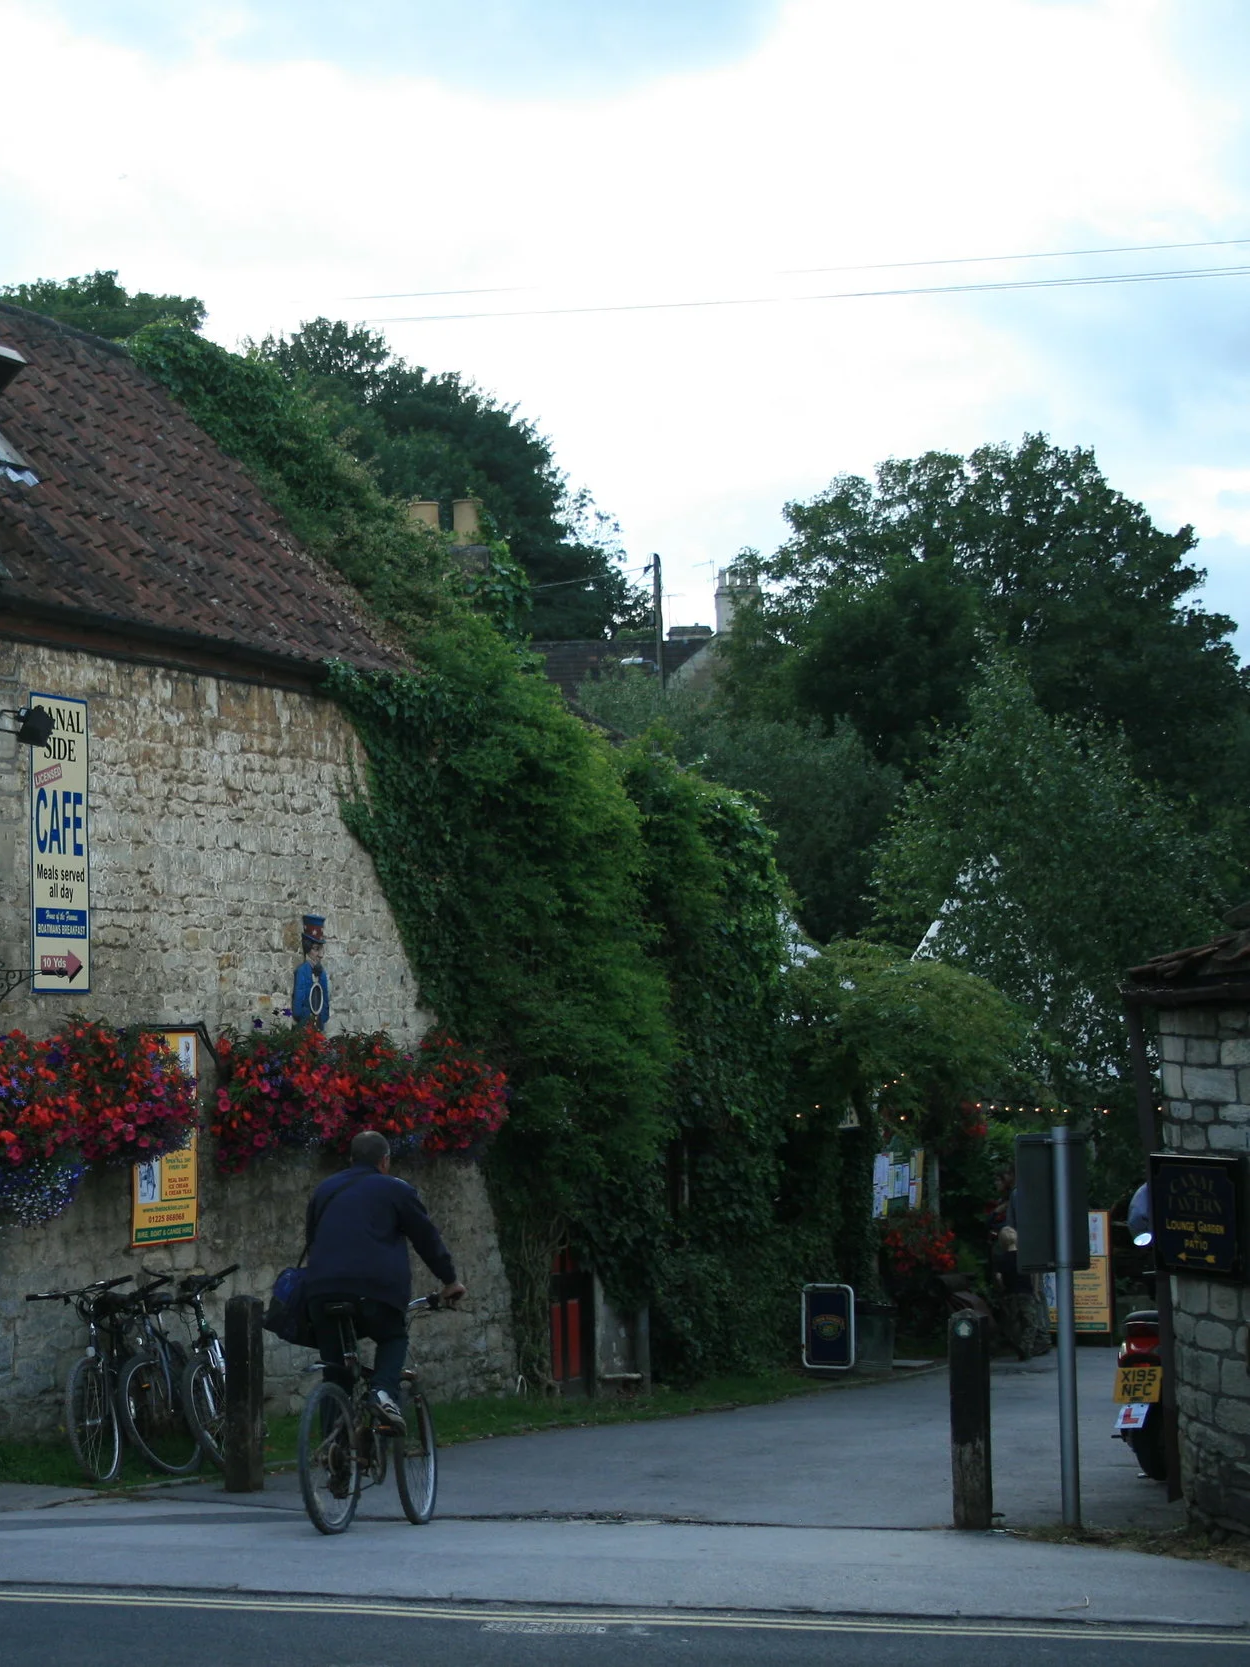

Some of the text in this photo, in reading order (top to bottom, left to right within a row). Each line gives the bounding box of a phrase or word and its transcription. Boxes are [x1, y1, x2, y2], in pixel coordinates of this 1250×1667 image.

[47, 706, 84, 734] NAL
[44, 736, 76, 762] SIDE
[35, 766, 62, 786] LICENSED
[36, 787, 84, 857] CAFE
[37, 863, 85, 883] Meals served
[49, 883, 74, 903] all day
[61, 924, 86, 936] BREAKFAST
[43, 957, 66, 968] 10 Yds
[148, 1214, 165, 1223] 01225
[1183, 1238, 1209, 1251] PATIO
[1121, 1369, 1157, 1383] X195
[1121, 1383, 1152, 1397] NFC
[1121, 1408, 1140, 1425] L
